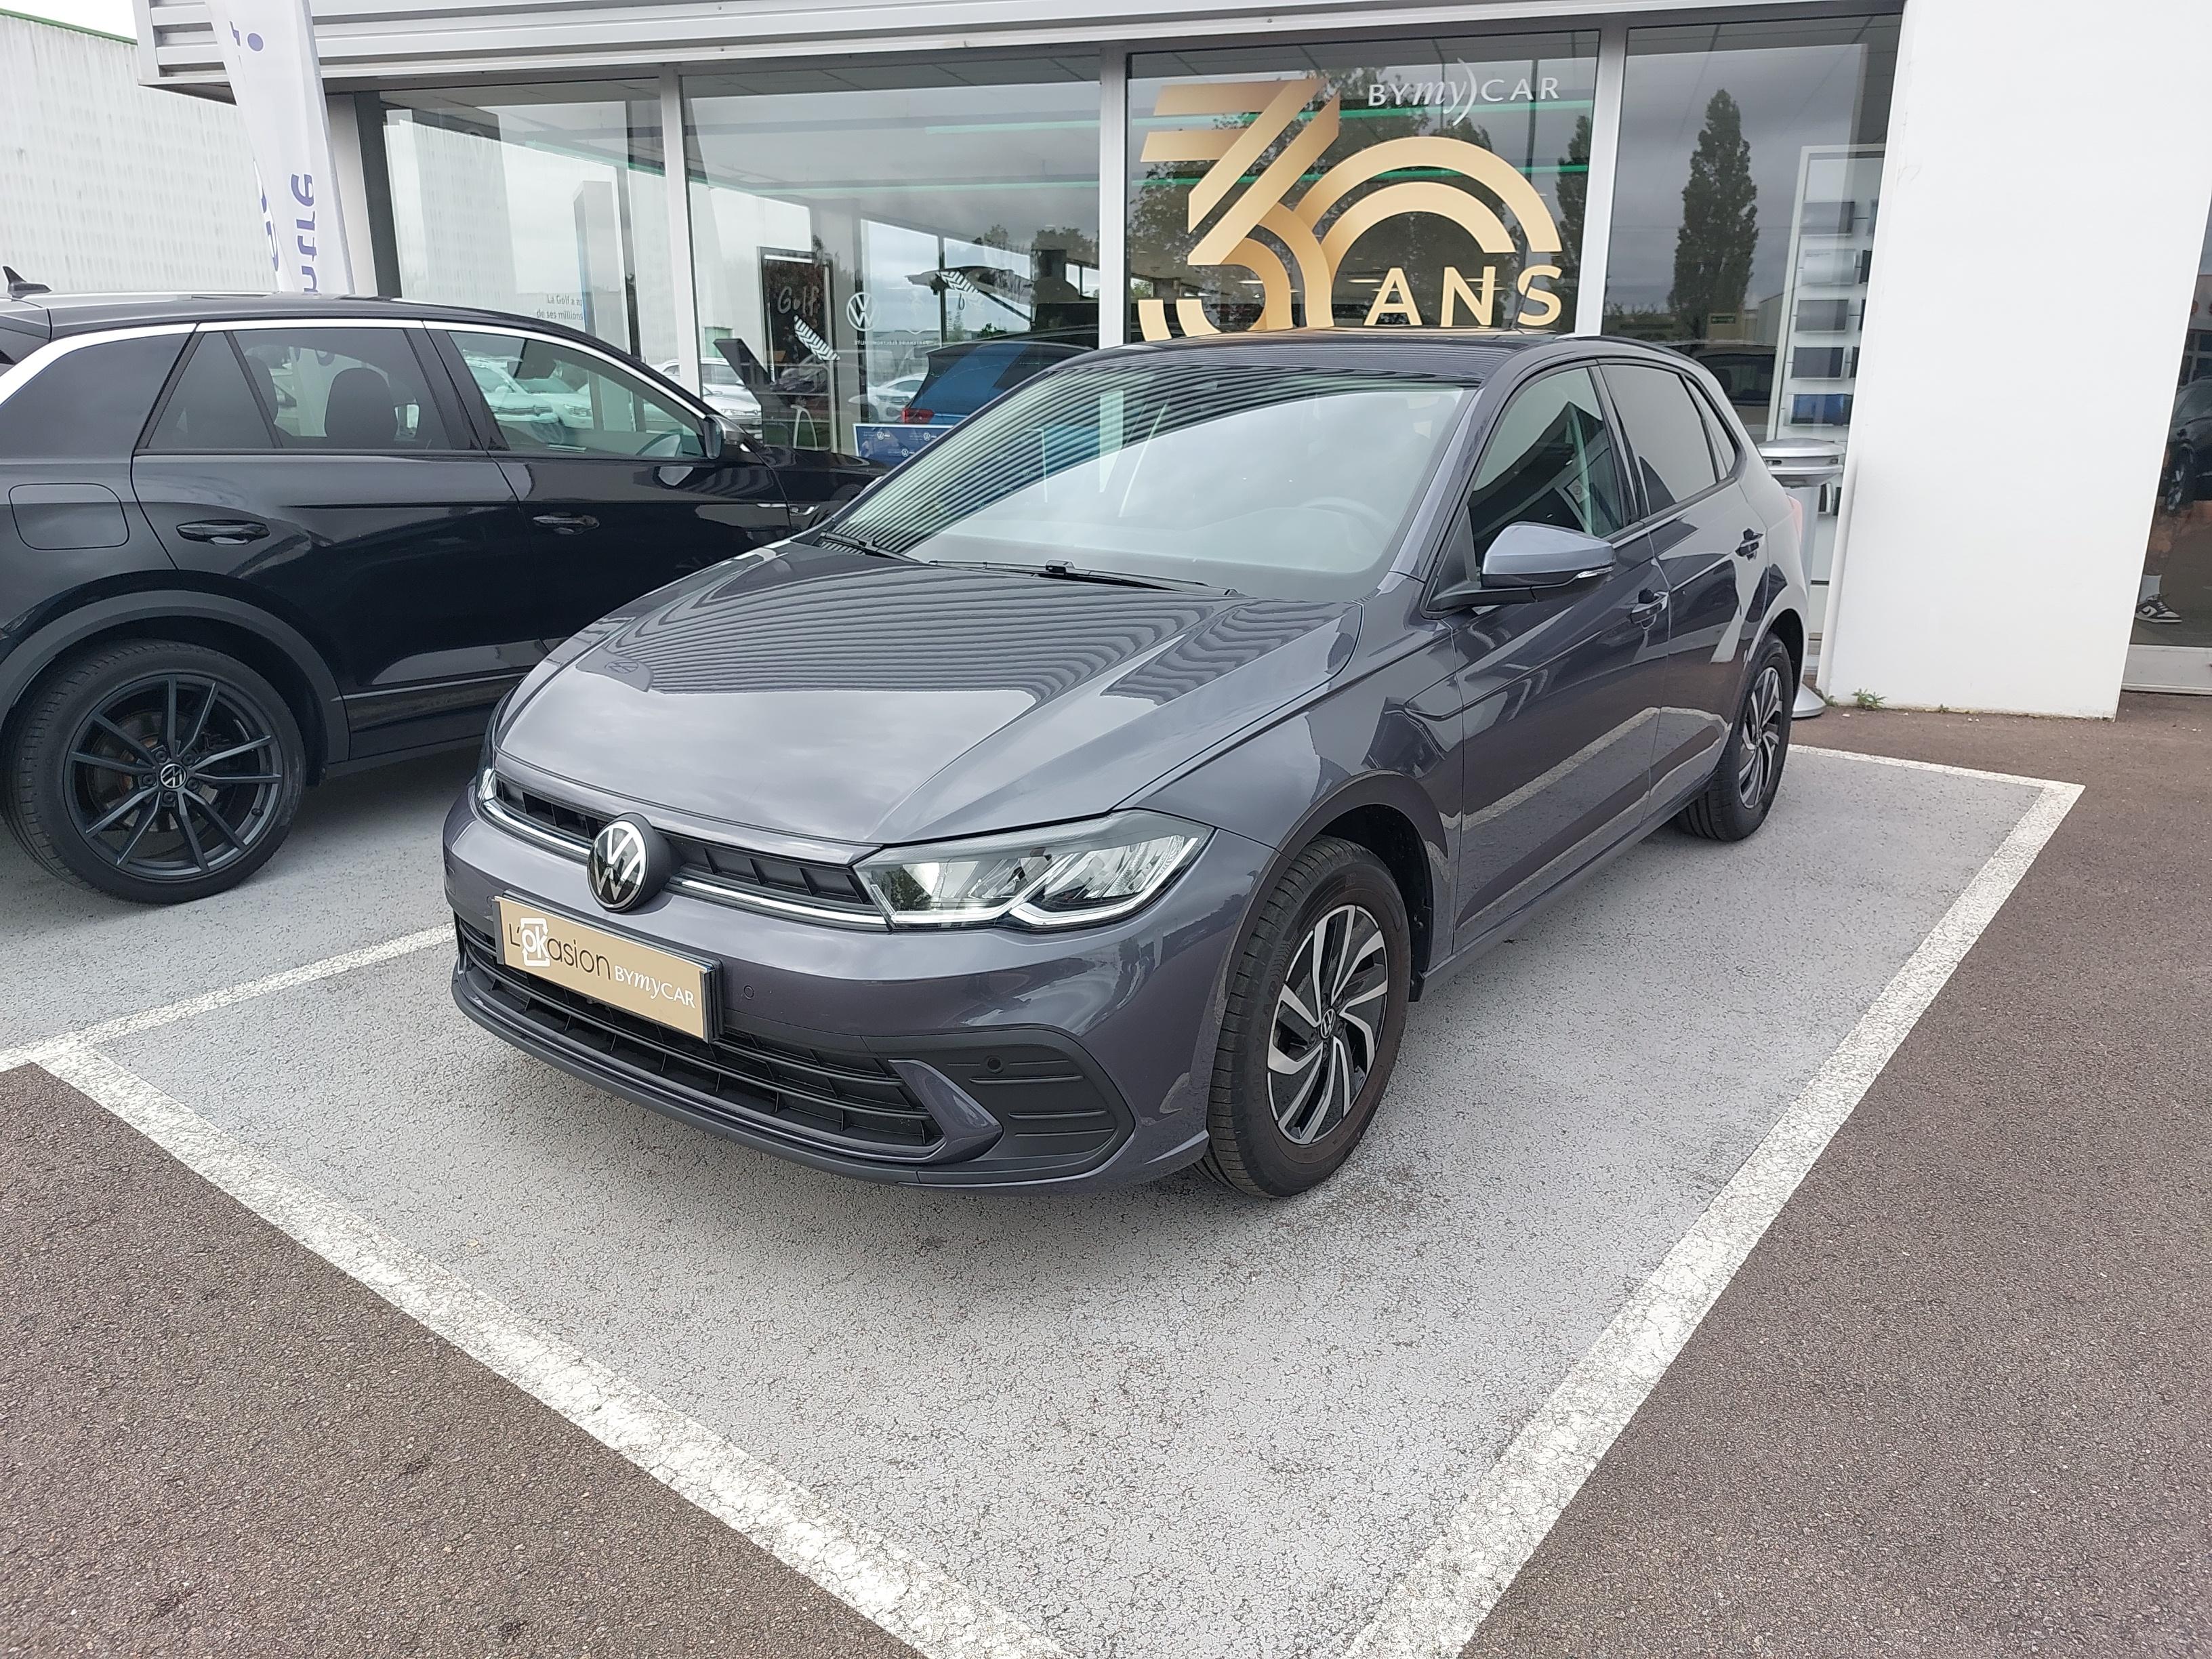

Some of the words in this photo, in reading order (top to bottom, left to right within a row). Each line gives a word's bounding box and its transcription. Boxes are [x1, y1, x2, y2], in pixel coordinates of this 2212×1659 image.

[547, 294, 555, 304] La
[556, 294, 570, 306] Golf
[777, 285, 820, 316] Golf
[1363, 264, 1563, 327] ANS
[536, 308, 546, 319] de
